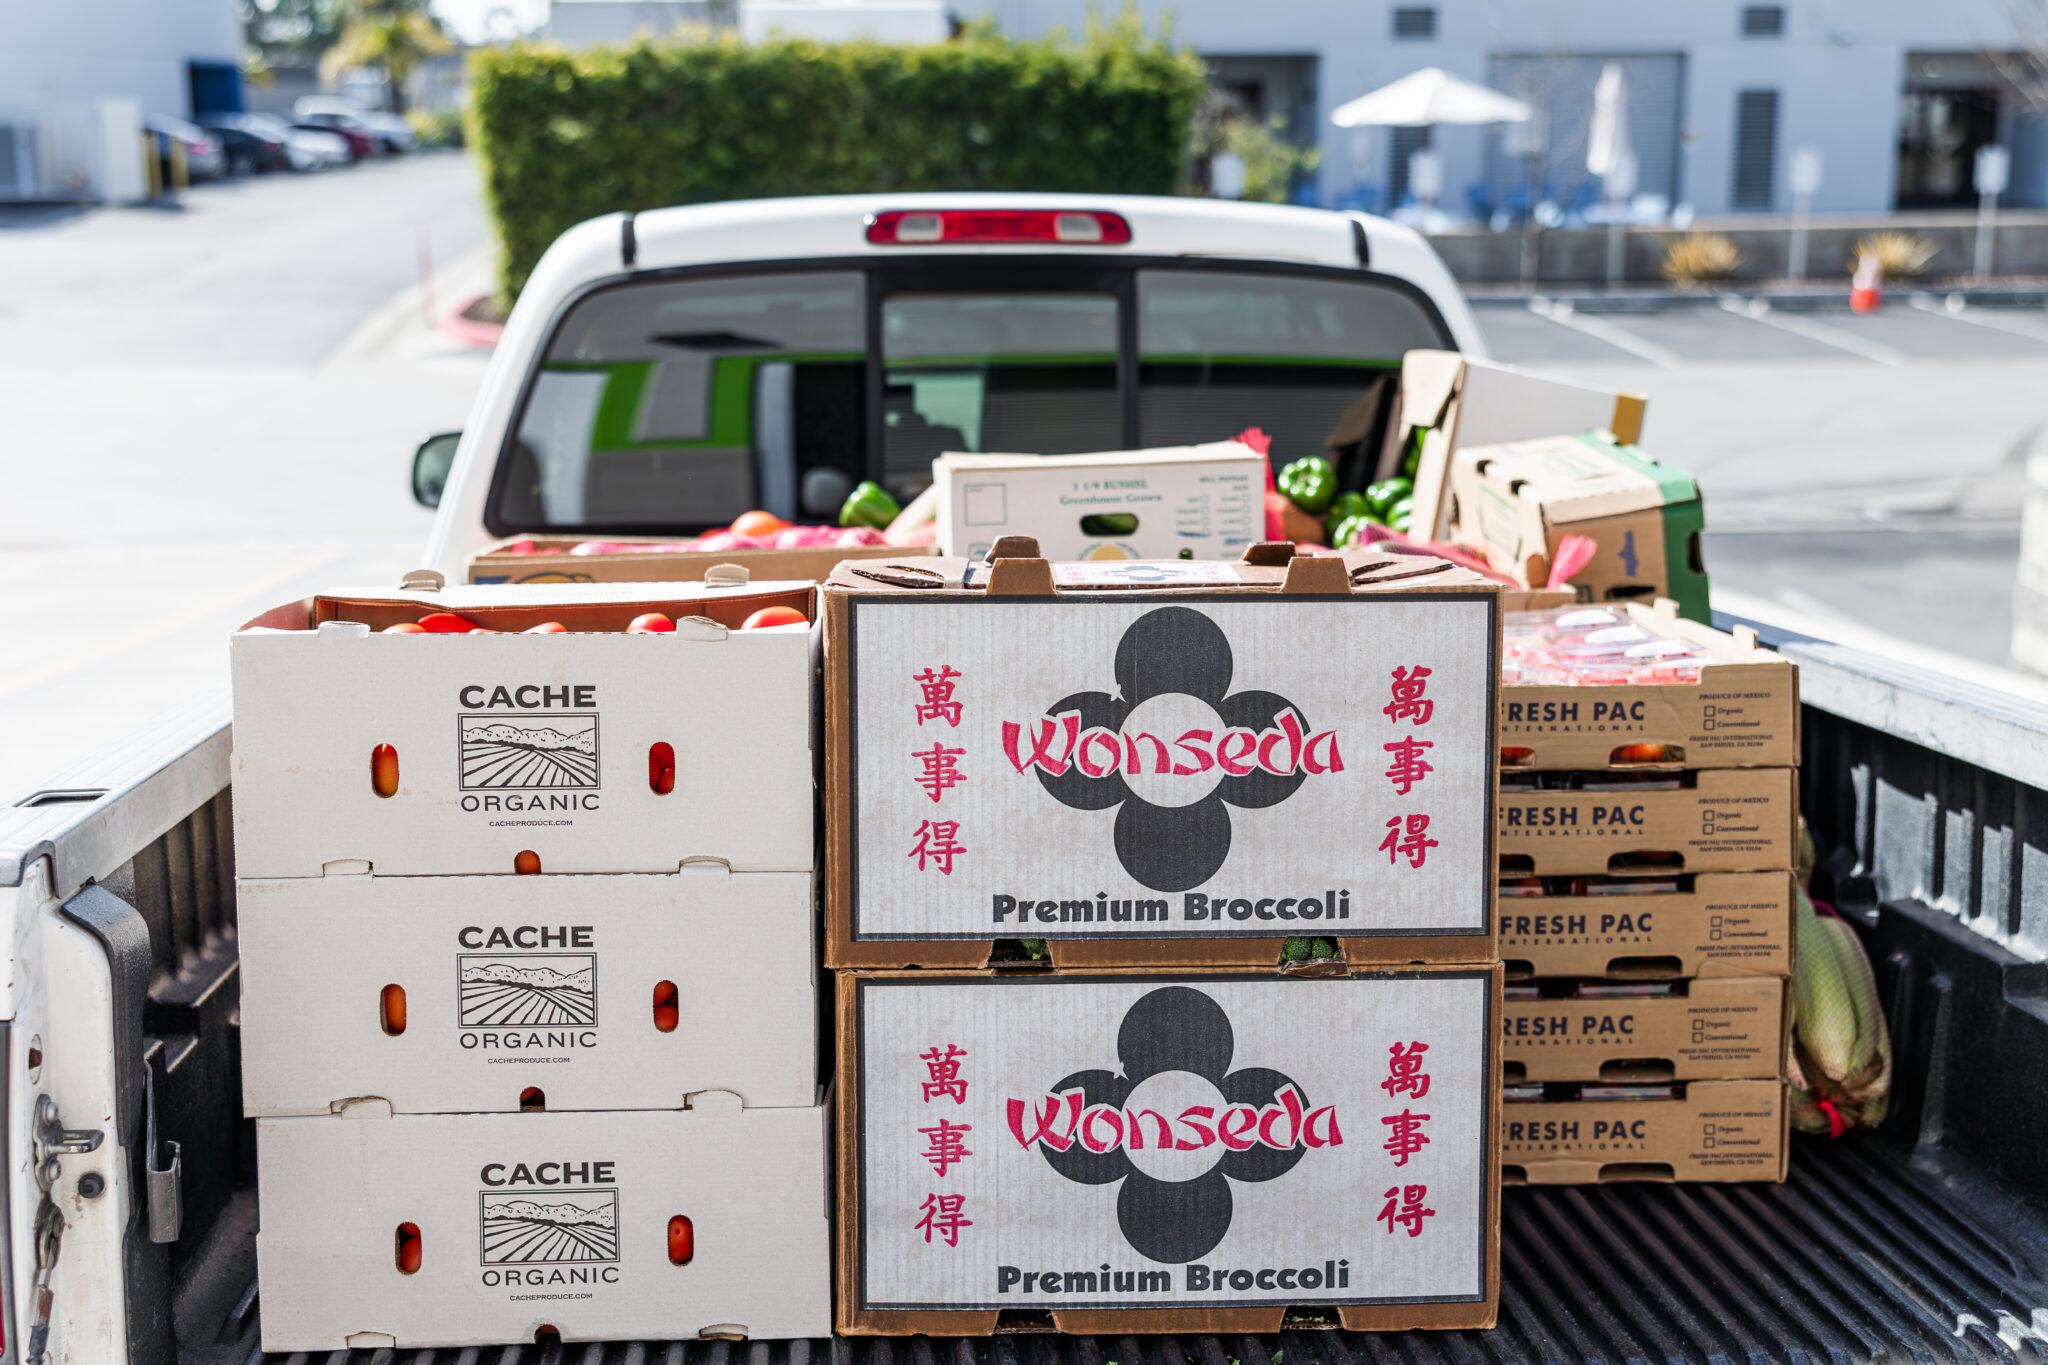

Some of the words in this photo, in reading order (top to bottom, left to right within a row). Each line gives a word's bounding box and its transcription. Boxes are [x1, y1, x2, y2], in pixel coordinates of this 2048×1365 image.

[459, 685, 596, 708] CACHE
[1501, 702, 1578, 722] RESH
[1594, 701, 1644, 721] PAC
[1718, 707, 1744, 716] Organic
[1502, 724, 1644, 732] NTERNATIONAL
[1717, 720, 1760, 728] Conventional
[1002, 712, 1345, 777] Wonseda
[461, 794, 600, 812] ORGANIC
[1592, 806, 1644, 825] PAC
[1717, 812, 1742, 820] Organic
[992, 892, 1169, 923] Premium
[1184, 890, 1350, 922] Broccoli
[1500, 915, 1586, 935] FRESH
[1601, 914, 1652, 933] PAC
[1724, 918, 1750, 926] Organic
[458, 926, 594, 949] CACHE
[1499, 936, 1651, 945] INTERNATIONAL
[1504, 1017, 1567, 1036] RESH
[1582, 1015, 1634, 1035] PAC
[1706, 1021, 1731, 1029] Organic
[460, 1032, 597, 1049] ORGANIC
[1007, 1088, 1344, 1153] Wonseda
[1502, 1122, 1579, 1141] RESH
[1594, 1120, 1645, 1139] PAC
[481, 1161, 615, 1186] CACHE
[482, 1267, 619, 1286] ORGANIC
[998, 1263, 1170, 1293] Premium
[1187, 1259, 1350, 1291] Broccoli
[510, 1293, 592, 1301] CACHEPRODUCE.COM
